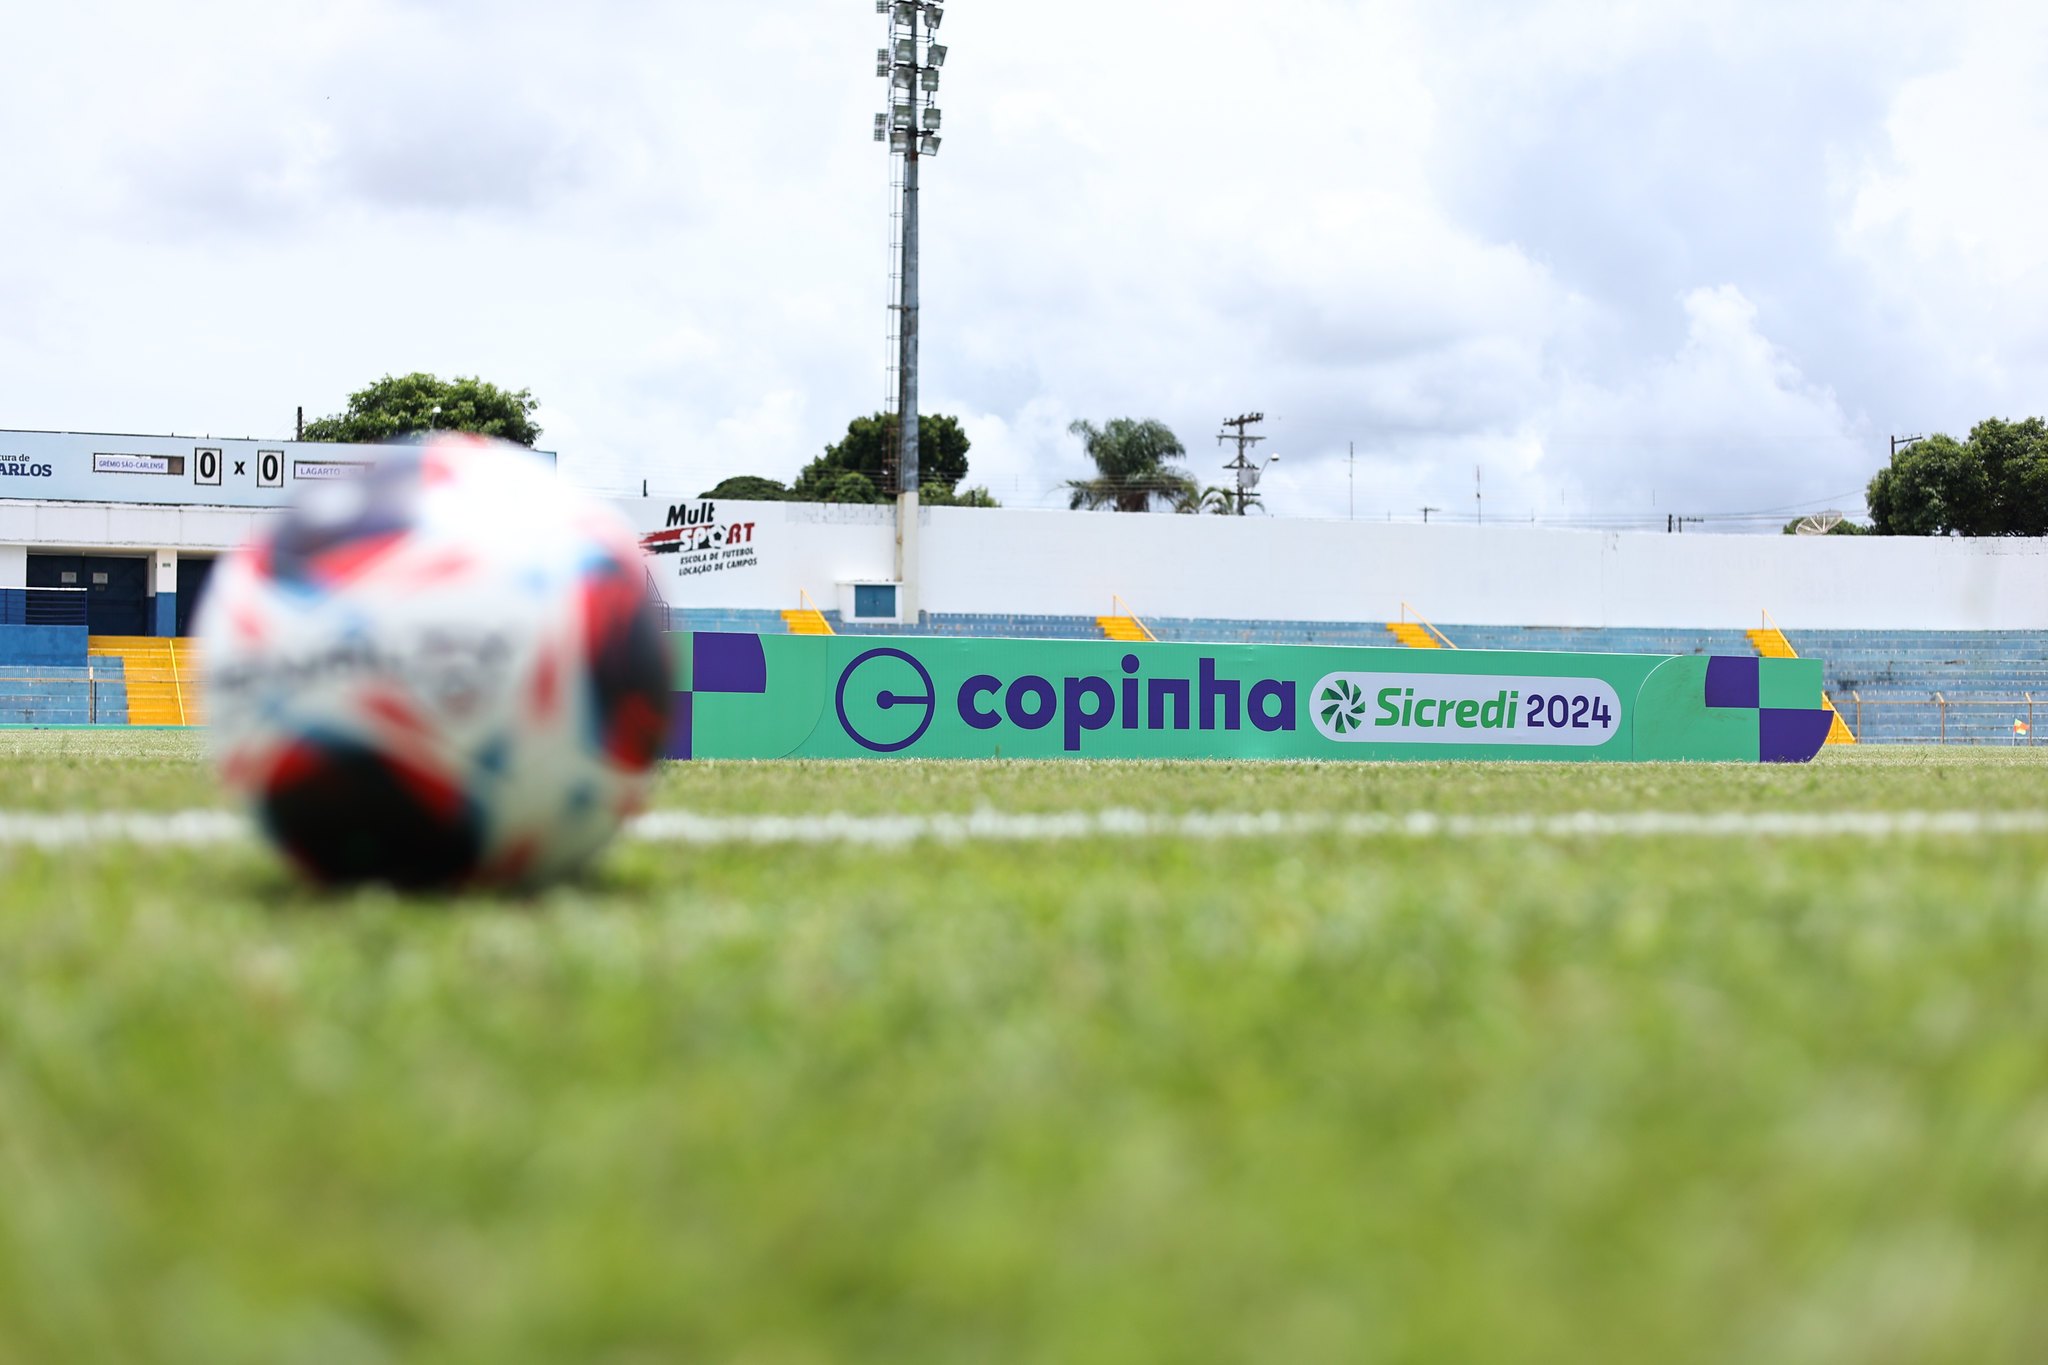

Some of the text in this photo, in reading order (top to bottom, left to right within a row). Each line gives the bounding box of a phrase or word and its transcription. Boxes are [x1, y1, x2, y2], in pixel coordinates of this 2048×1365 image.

[19, 454, 30, 462] de
[200, 451, 216, 478] 0
[262, 454, 279, 481] 0
[300, 466, 341, 476] LAGARTO
[665, 501, 715, 528] Mult
[680, 547, 754, 565] ESCOLA DE FUTEBOL
[679, 557, 758, 576] LOCAÇÃO DE CAMPOS
[957, 653, 1612, 751] copinha Sicredi 2024
